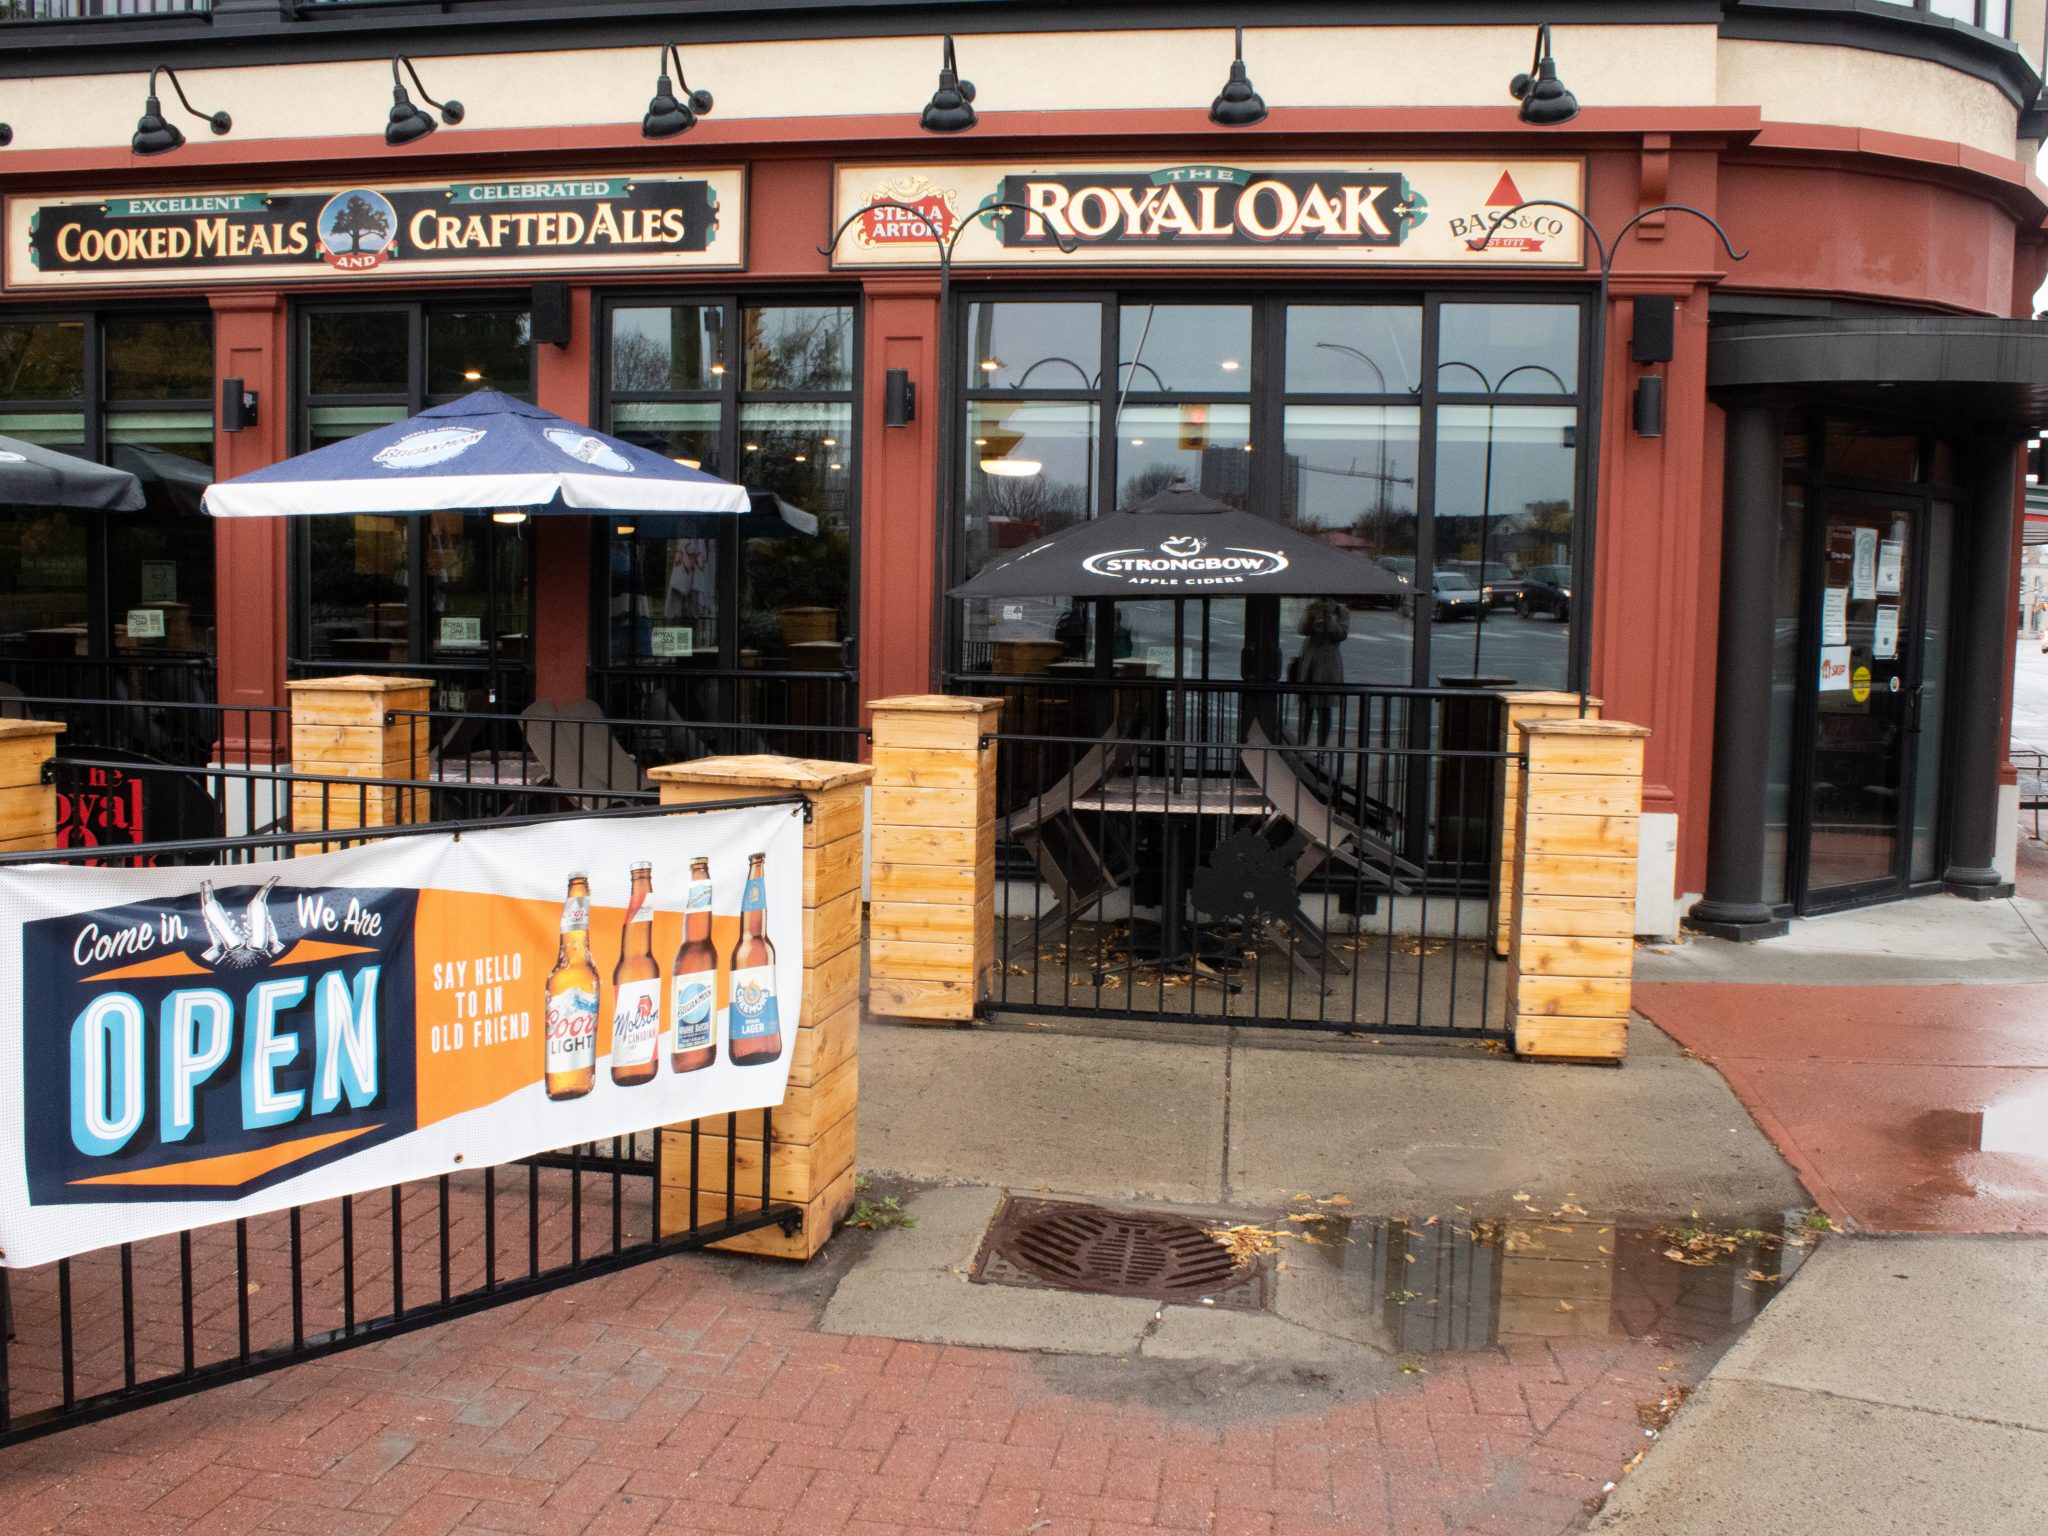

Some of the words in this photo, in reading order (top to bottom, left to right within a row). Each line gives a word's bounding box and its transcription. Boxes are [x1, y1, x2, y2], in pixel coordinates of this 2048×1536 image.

[468, 182, 610, 200] CELEBRATED
[1167, 169, 1235, 182] THE
[129, 196, 245, 214] EXCELLENT
[1022, 182, 1235, 239] ROYAL
[1235, 180, 1392, 241] OAK
[56, 222, 191, 262] COOKED
[194, 217, 309, 258] MEALS
[409, 208, 585, 250] CRAFTED
[584, 203, 685, 244] ALES
[872, 222, 944, 237] ARTOIS
[337, 255, 376, 268] AND
[1106, 557, 1264, 572] STRONGBOW
[1127, 576, 1179, 585] APPLE
[1185, 575, 1245, 585] CIDERS
[296, 893, 338, 931] We
[344, 897, 383, 937] Are
[73, 922, 155, 966] Come
[161, 912, 188, 945] in
[433, 960, 467, 991] SAY
[475, 952, 522, 986] HELLO
[455, 990, 478, 1019] TO
[485, 985, 503, 1015] AN
[431, 1022, 464, 1054] OLD
[474, 1011, 529, 1048] FRIEND
[614, 1008, 659, 1042] Molson
[741, 1022, 765, 1035] LAGER
[70, 965, 381, 1157] OPEN
[551, 1035, 593, 1055] LIGHT
